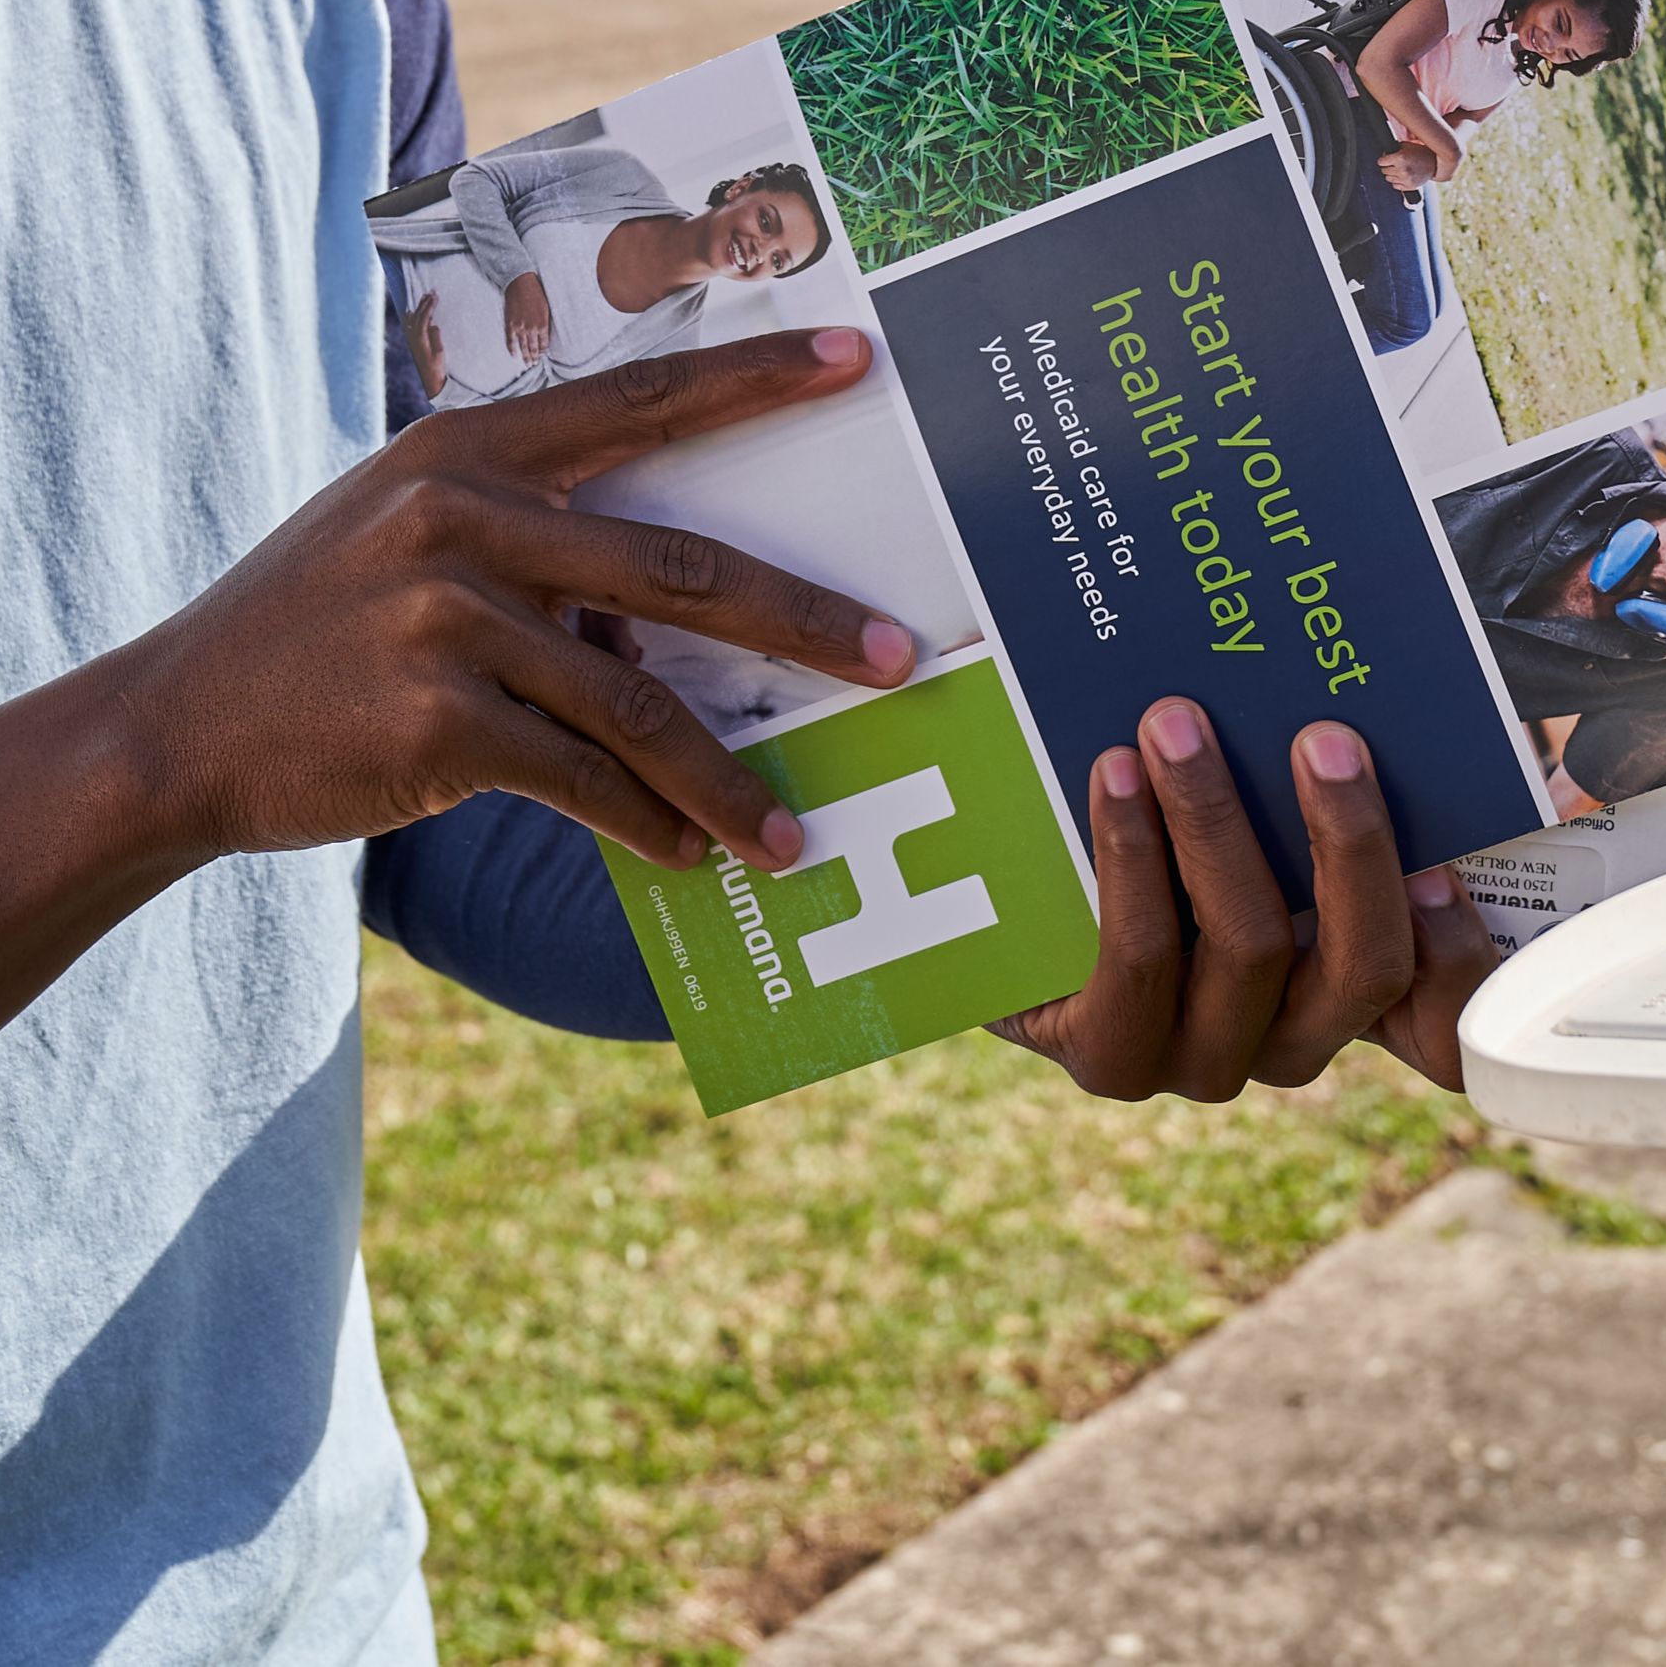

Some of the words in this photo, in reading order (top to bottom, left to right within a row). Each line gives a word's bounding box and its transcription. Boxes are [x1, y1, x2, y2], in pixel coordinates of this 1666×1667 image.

[979, 335, 1026, 403] your
[1013, 412, 1080, 545] everyday
[1067, 552, 1119, 641] needs
[1024, 320, 1098, 459] Medicaid
[1080, 466, 1117, 529] care
[1106, 534, 1140, 578] for
[1092, 288, 1198, 480] health
[1171, 489, 1265, 652] today
[1169, 260, 1257, 407] Start
[1217, 415, 1310, 546] your
[1287, 561, 1371, 695] best
[1520, 861, 1558, 876] NEW
[1523, 880, 1554, 892] 1250
[1569, 816, 1616, 832] Official
[683, 974, 707, 1011] 0619
